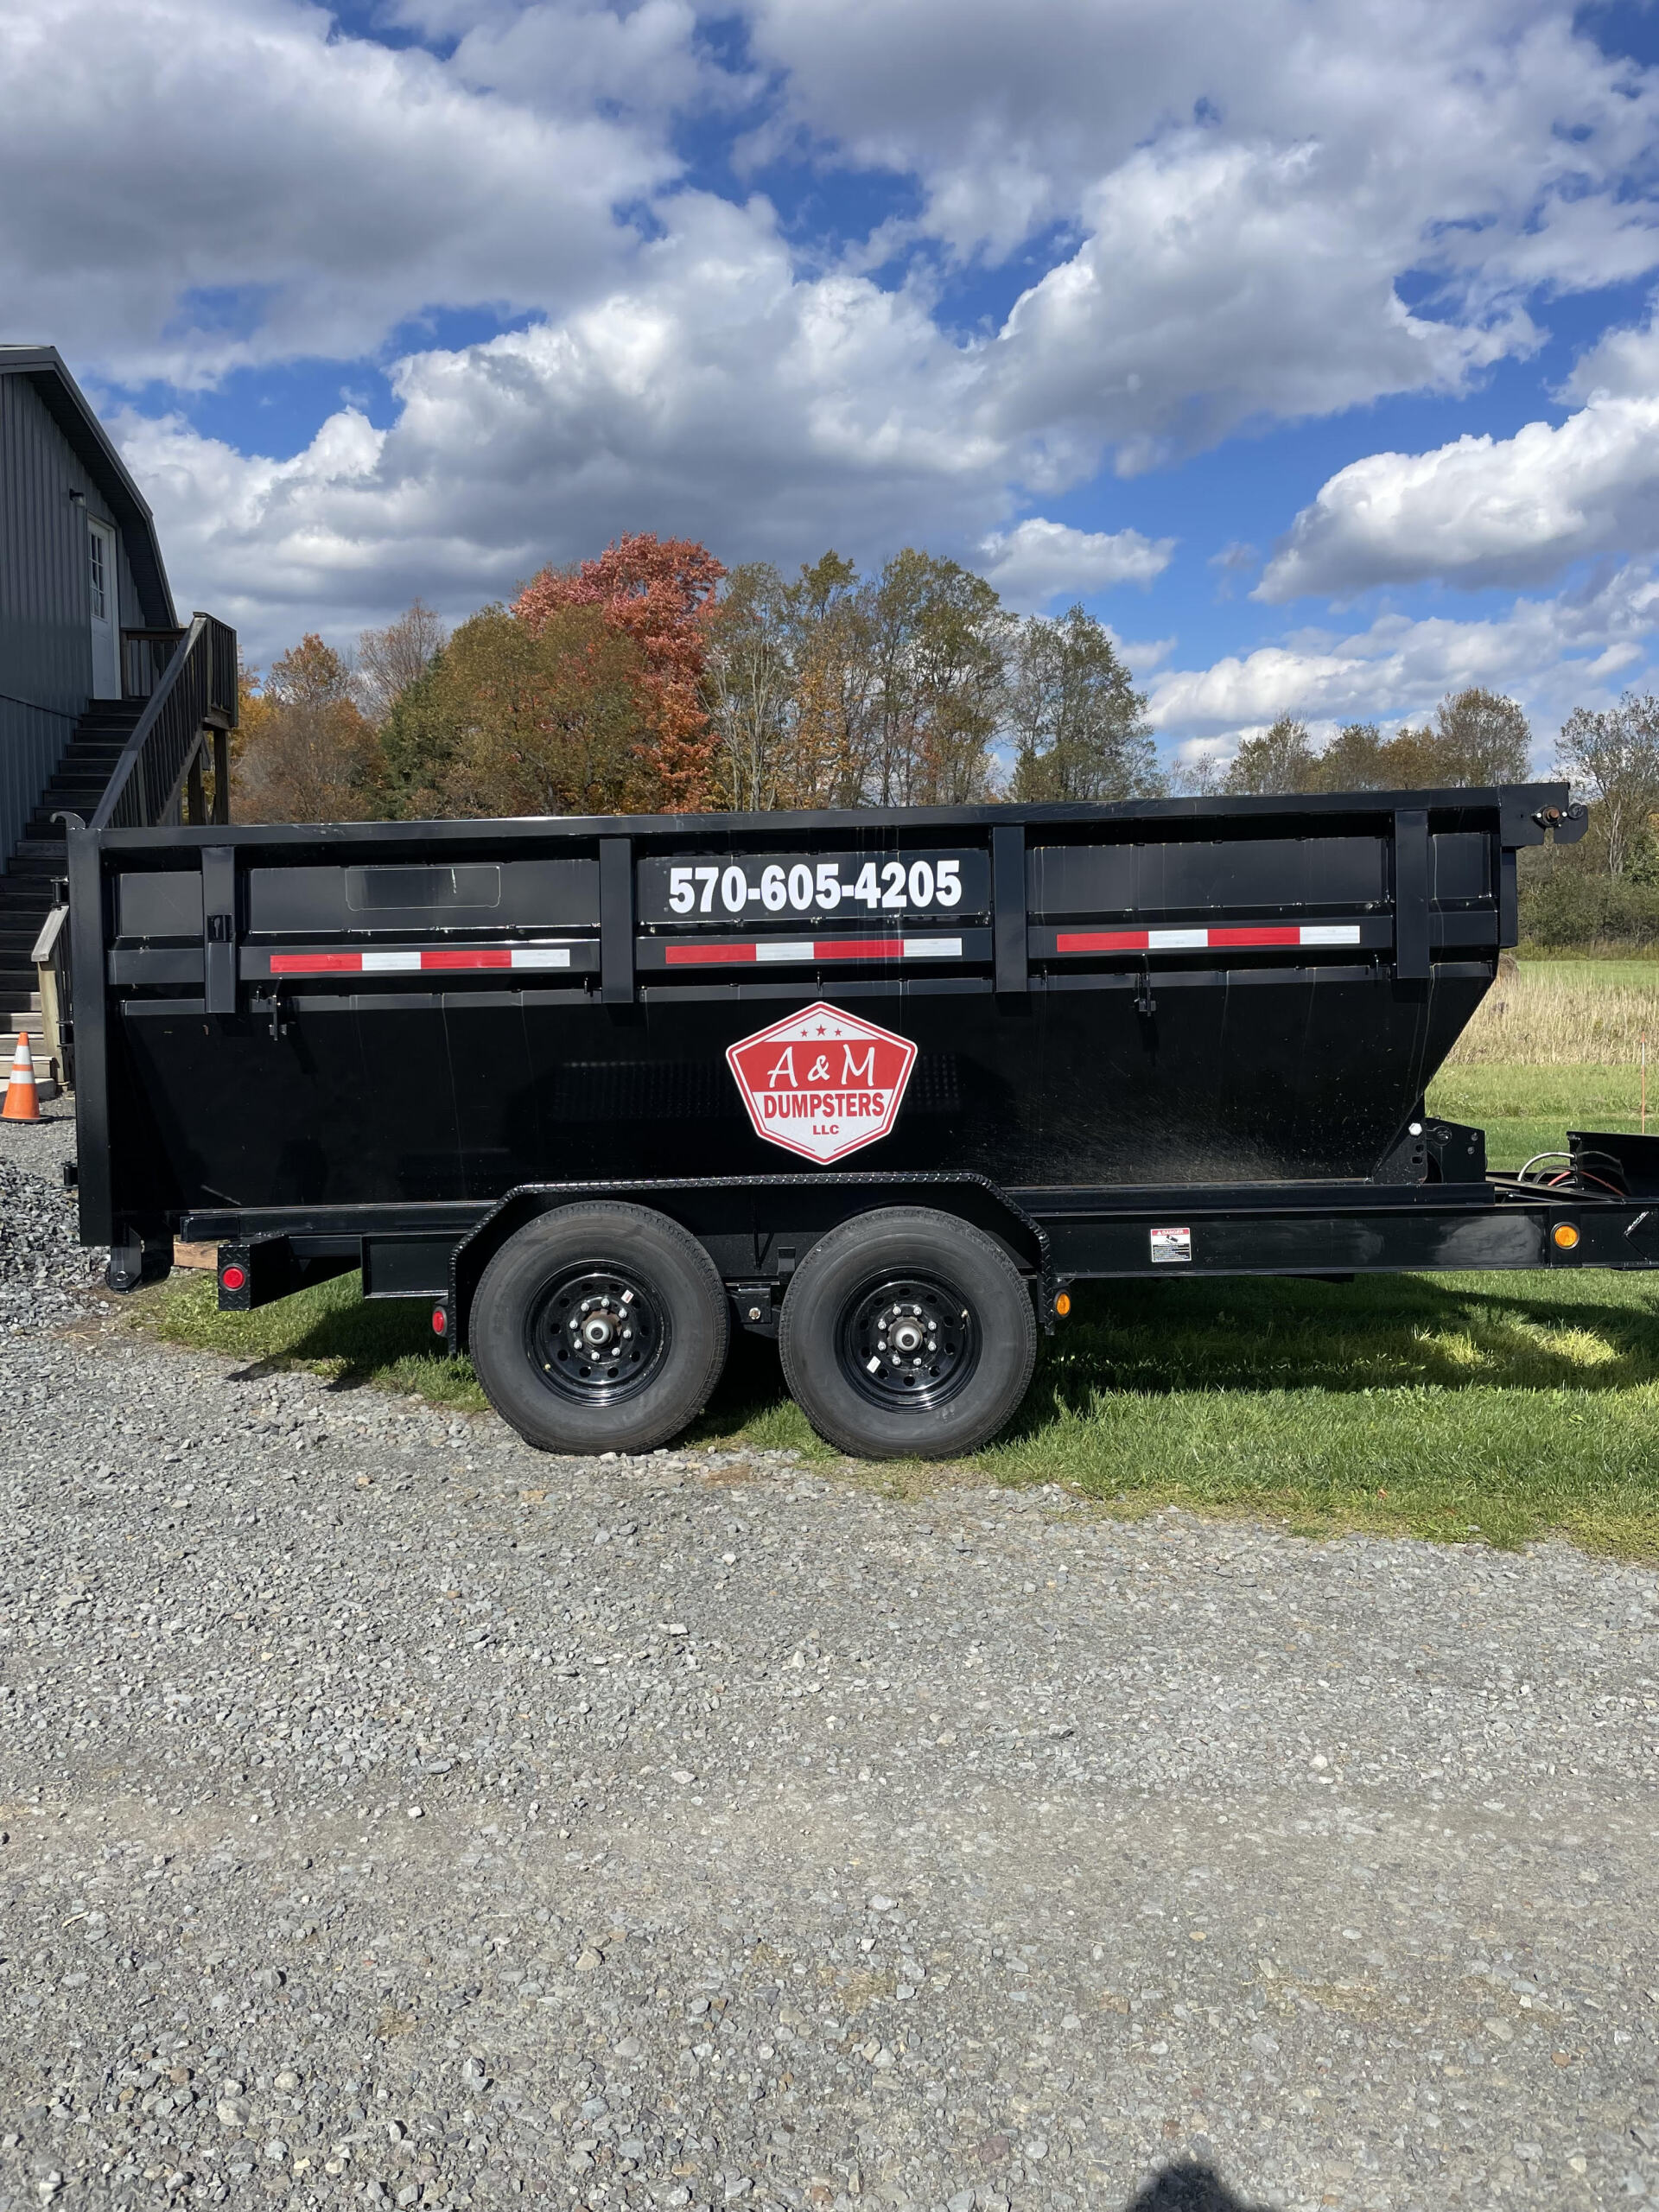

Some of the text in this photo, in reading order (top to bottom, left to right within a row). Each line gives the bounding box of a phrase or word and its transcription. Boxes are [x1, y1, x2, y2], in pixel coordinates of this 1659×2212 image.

[669, 860, 962, 913] 570-605-4205
[766, 1044, 875, 1088] A & M
[763, 1092, 885, 1119] DUMPSTERS
[812, 1124, 839, 1135] LLC
